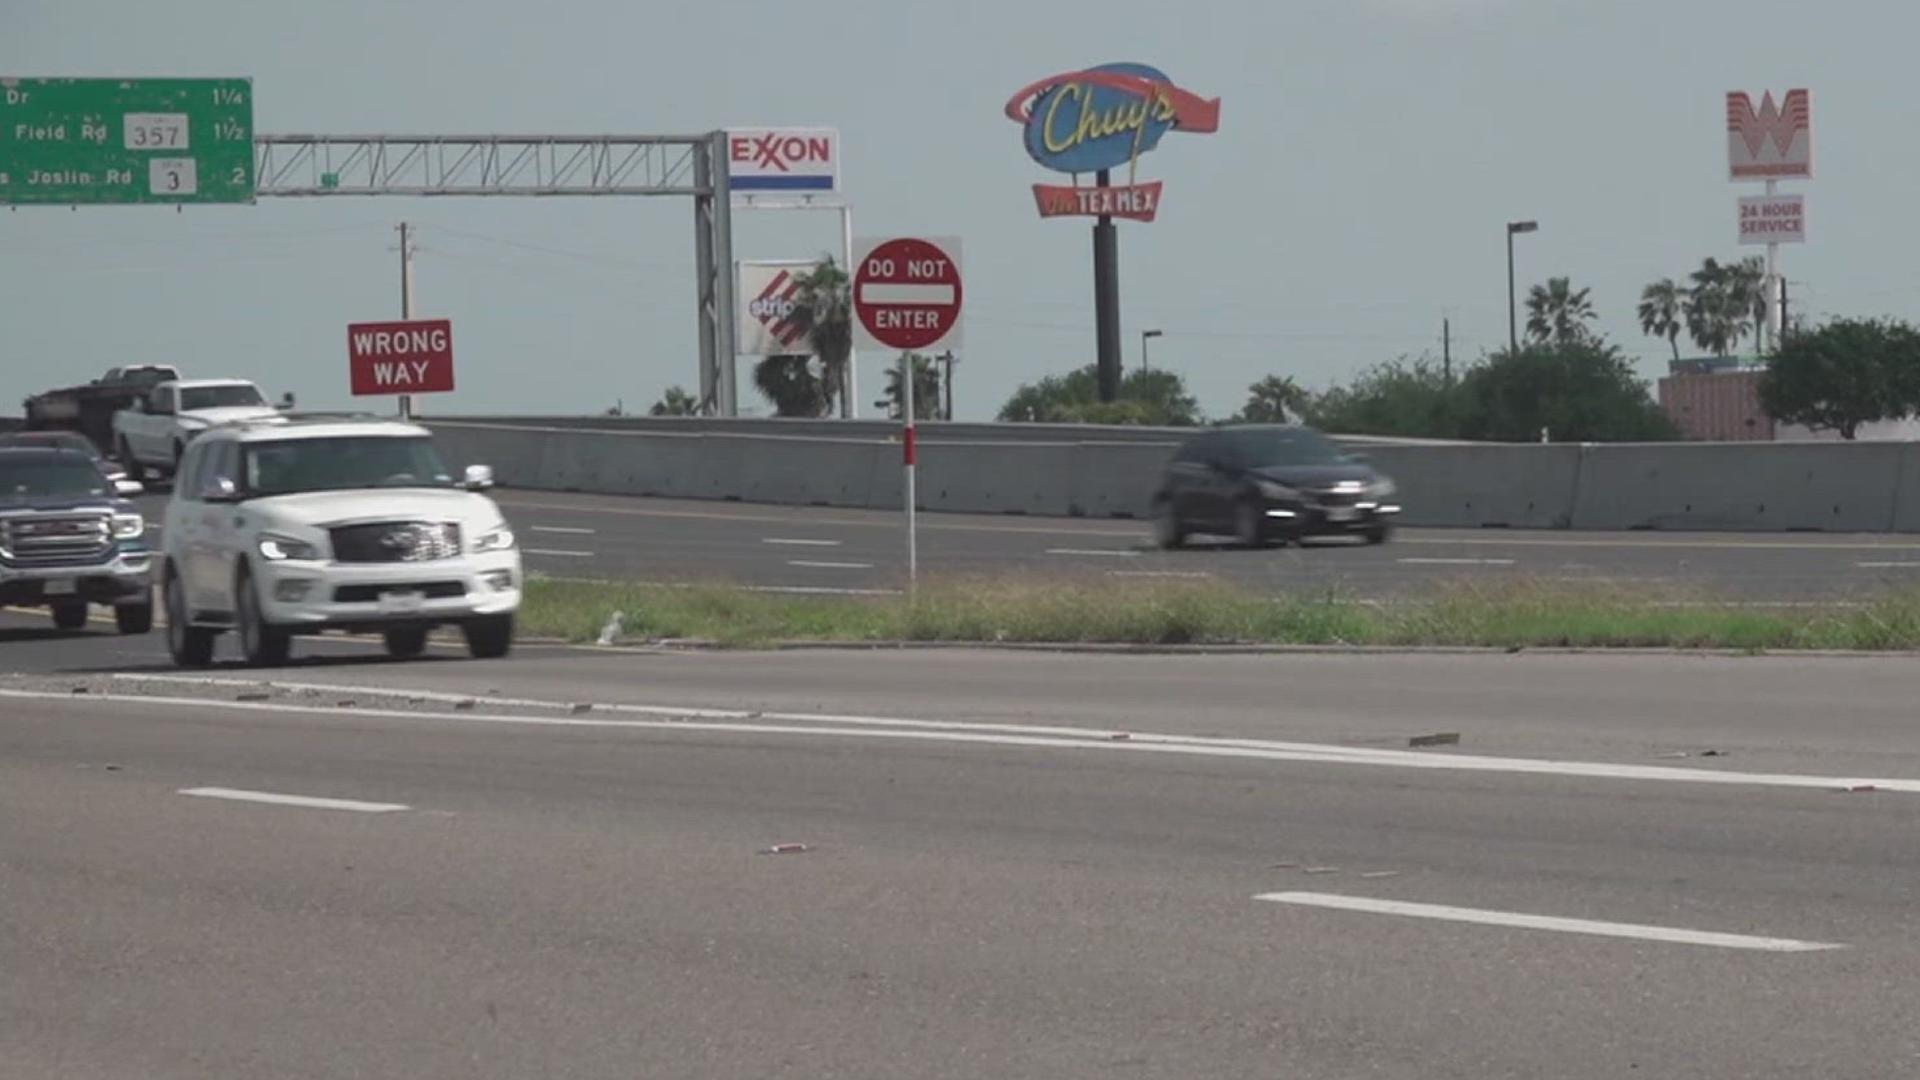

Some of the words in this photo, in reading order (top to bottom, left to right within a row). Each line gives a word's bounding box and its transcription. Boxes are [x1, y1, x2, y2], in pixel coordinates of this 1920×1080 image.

[7, 90, 29, 104] Dr
[15, 124, 65, 140] Field
[81, 124, 107, 141] Rd
[134, 126, 178, 146] 357
[731, 132, 830, 172] EXXON
[27, 170, 91, 184] Joslin
[106, 169, 133, 185] Rd
[167, 171, 180, 191] 3
[231, 167, 246, 185] 2
[1076, 190, 1112, 213] TEX
[1740, 204, 1758, 218] 24
[1762, 203, 1801, 217] HOUR
[1740, 219, 1801, 234] SERVICE
[868, 259, 895, 277] DO
[907, 260, 946, 277] NOT
[875, 310, 939, 329] ENTER
[353, 329, 447, 356] WRONG
[373, 361, 430, 386] WAY
